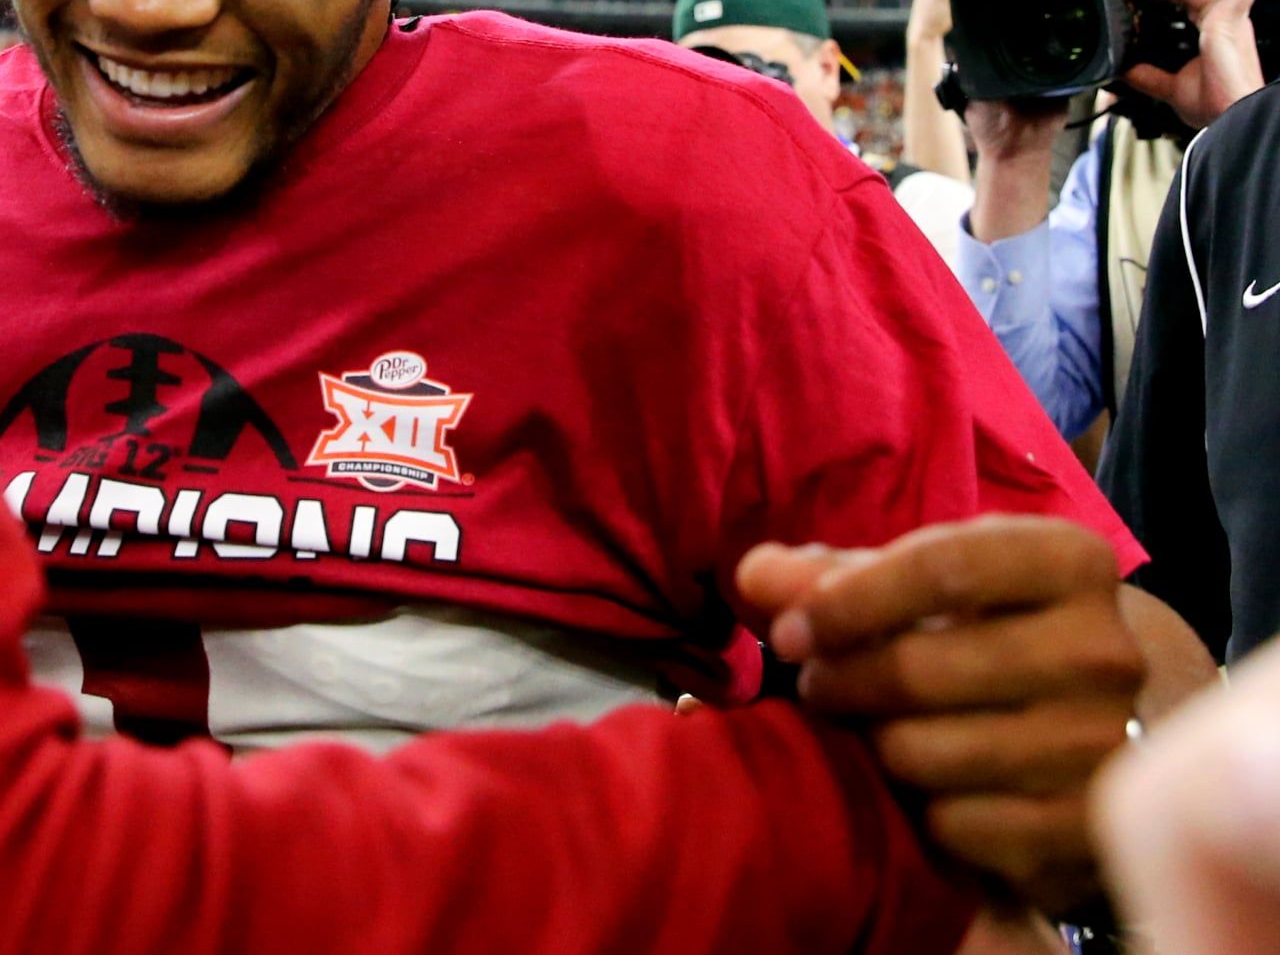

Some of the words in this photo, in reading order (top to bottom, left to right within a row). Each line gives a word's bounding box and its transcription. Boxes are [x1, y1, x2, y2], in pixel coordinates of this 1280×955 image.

[377, 358, 420, 382] Pepper
[391, 357, 409, 369] Dr
[323, 388, 457, 469] XII
[117, 439, 171, 482] 12
[337, 461, 429, 481] CHAMPIONSHIP
